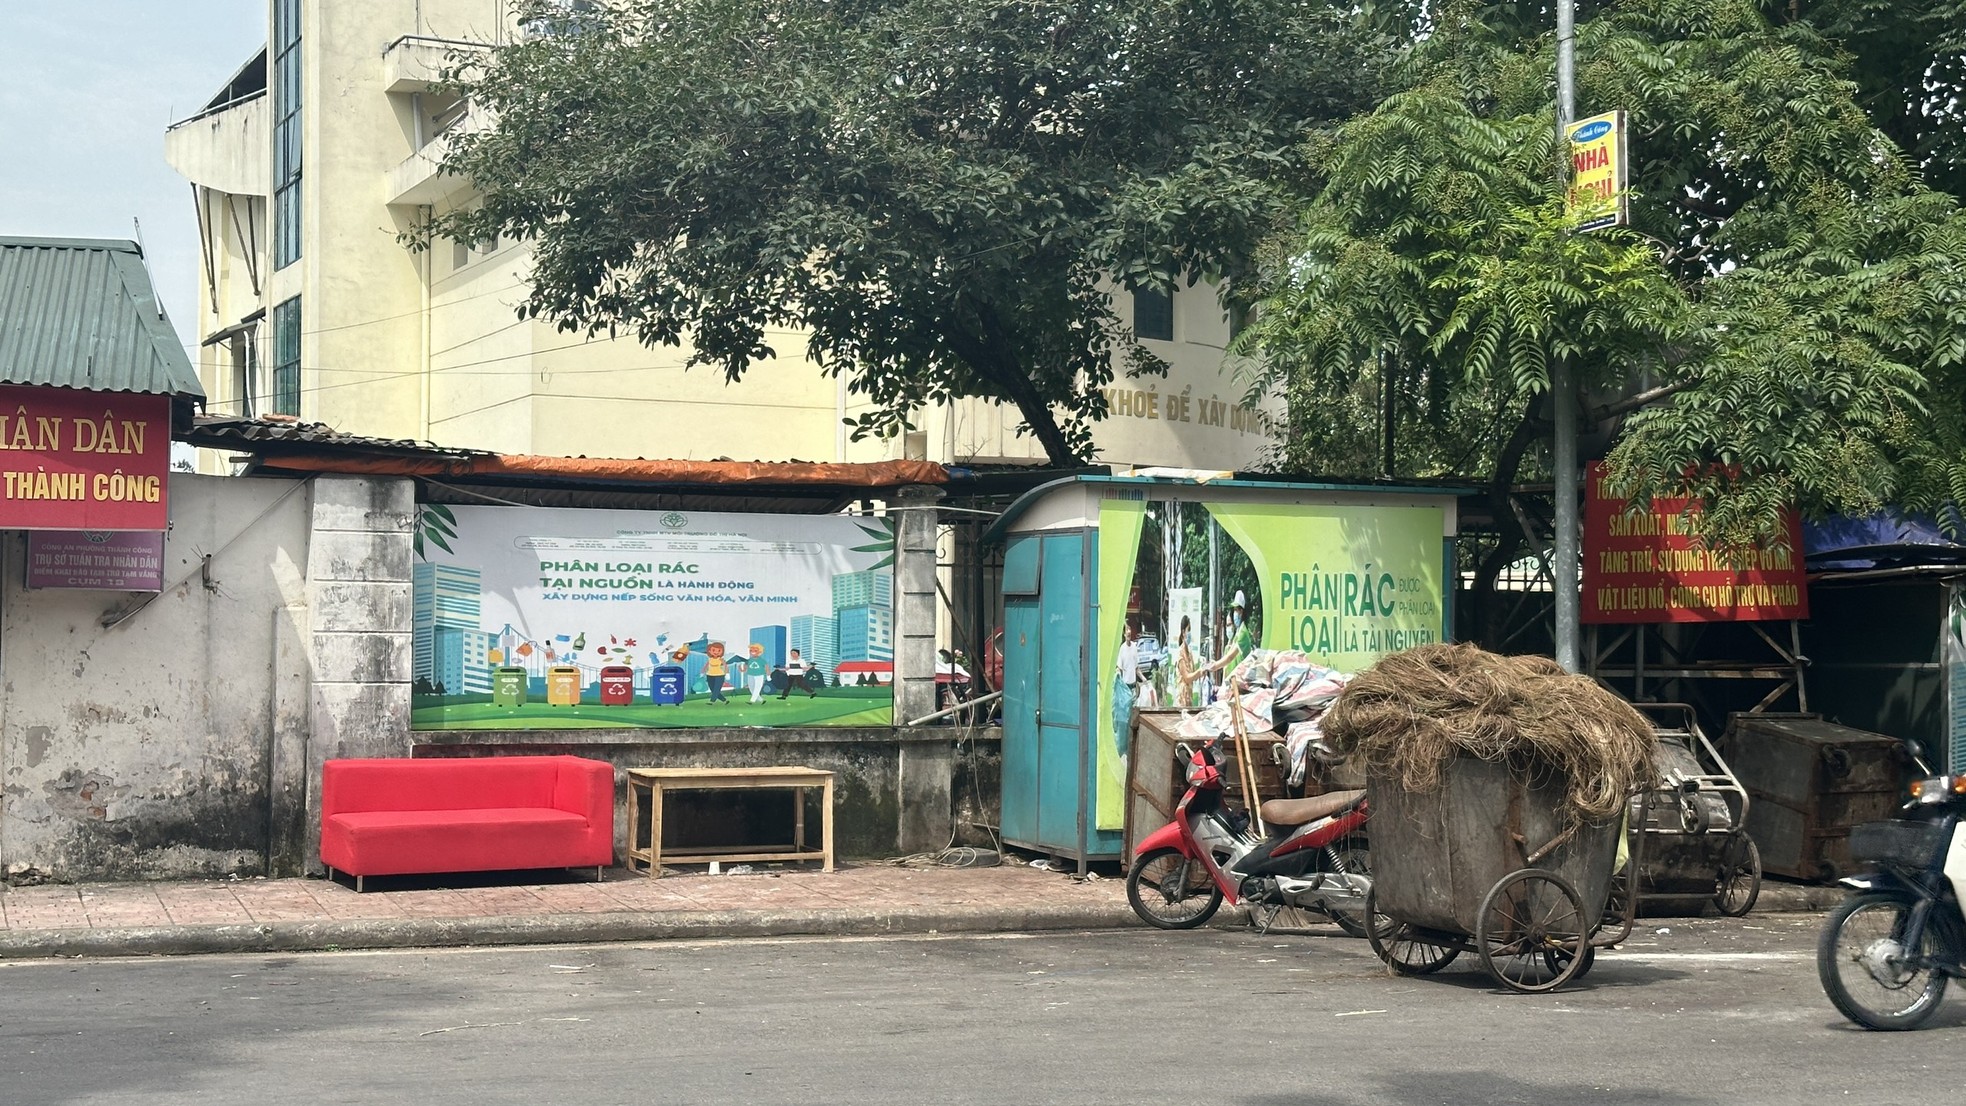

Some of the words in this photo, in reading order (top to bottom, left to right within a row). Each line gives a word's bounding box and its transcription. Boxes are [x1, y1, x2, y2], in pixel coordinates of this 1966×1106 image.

[1166, 384, 1191, 422] ĐỂ
[1197, 394, 1227, 428] XÂY
[73, 409, 147, 454] DÂN
[3, 466, 86, 500] THÀNH
[93, 469, 160, 503] CÔNG
[35, 553, 52, 567] TRỤ
[54, 550, 67, 566] SỞ
[94, 555, 110, 567] TRA
[113, 554, 137, 568] NHÂN
[140, 555, 158, 569] DÂN
[540, 560, 599, 572] PHÂN
[605, 562, 652, 576] LOẠI
[658, 561, 699, 574] RÁC
[1600, 547, 1629, 573] TÀNG
[1658, 540, 1673, 572] SỬ
[1674, 549, 1704, 577] DỤNG
[539, 578, 573, 590] TẠI
[579, 576, 653, 589] NGUỒN
[658, 580, 674, 588] LÀ
[677, 580, 715, 589] HÀNH
[718, 580, 755, 590] ĐỘNG
[542, 592, 569, 601] XÂY
[571, 592, 608, 603] DỰNG
[611, 592, 637, 601] NẾP
[639, 592, 674, 602] SỐNG
[676, 594, 703, 602] VĂN
[706, 594, 735, 603] HÓA,
[738, 594, 764, 603] VĂN
[767, 595, 798, 603] MINH
[1281, 563, 1338, 610] PHÂN
[1344, 563, 1395, 617] RÁC
[1598, 583, 1619, 615] VẬT
[1621, 583, 1646, 614] LIỆU
[1670, 581, 1701, 609] CÔNG
[1702, 585, 1717, 612] CỤ
[1718, 577, 1733, 608] HỖ
[1734, 583, 1756, 611] TRỢ
[1756, 580, 1771, 607] VÀ
[1771, 580, 1799, 606] PHÁO
[1399, 599, 1418, 615] PHÂN
[1291, 615, 1338, 657] LOẠI
[1344, 623, 1359, 652] LÀ
[1362, 623, 1381, 652] TÀI
[1385, 623, 1435, 652] NGUYÊN
